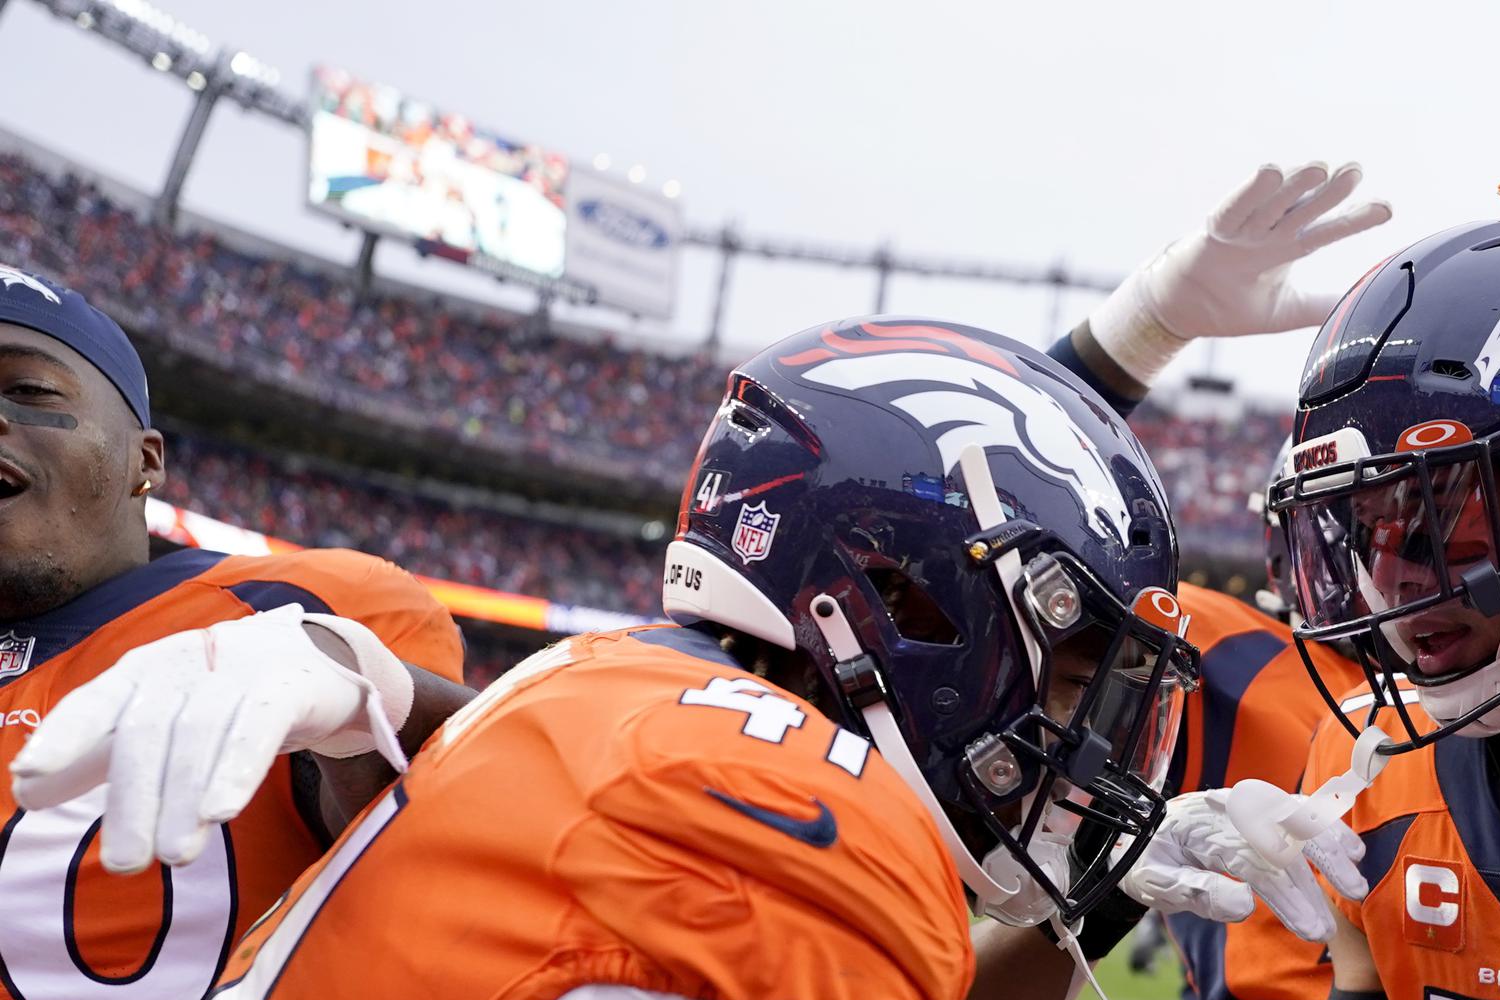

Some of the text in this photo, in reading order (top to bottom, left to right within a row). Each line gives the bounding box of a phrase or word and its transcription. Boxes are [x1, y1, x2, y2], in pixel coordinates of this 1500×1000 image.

[696, 472, 723, 512] 41
[737, 527, 765, 553] NFL
[670, 564, 702, 591] OF US
[0, 652, 20, 669] FL
[1405, 863, 1460, 927] C
